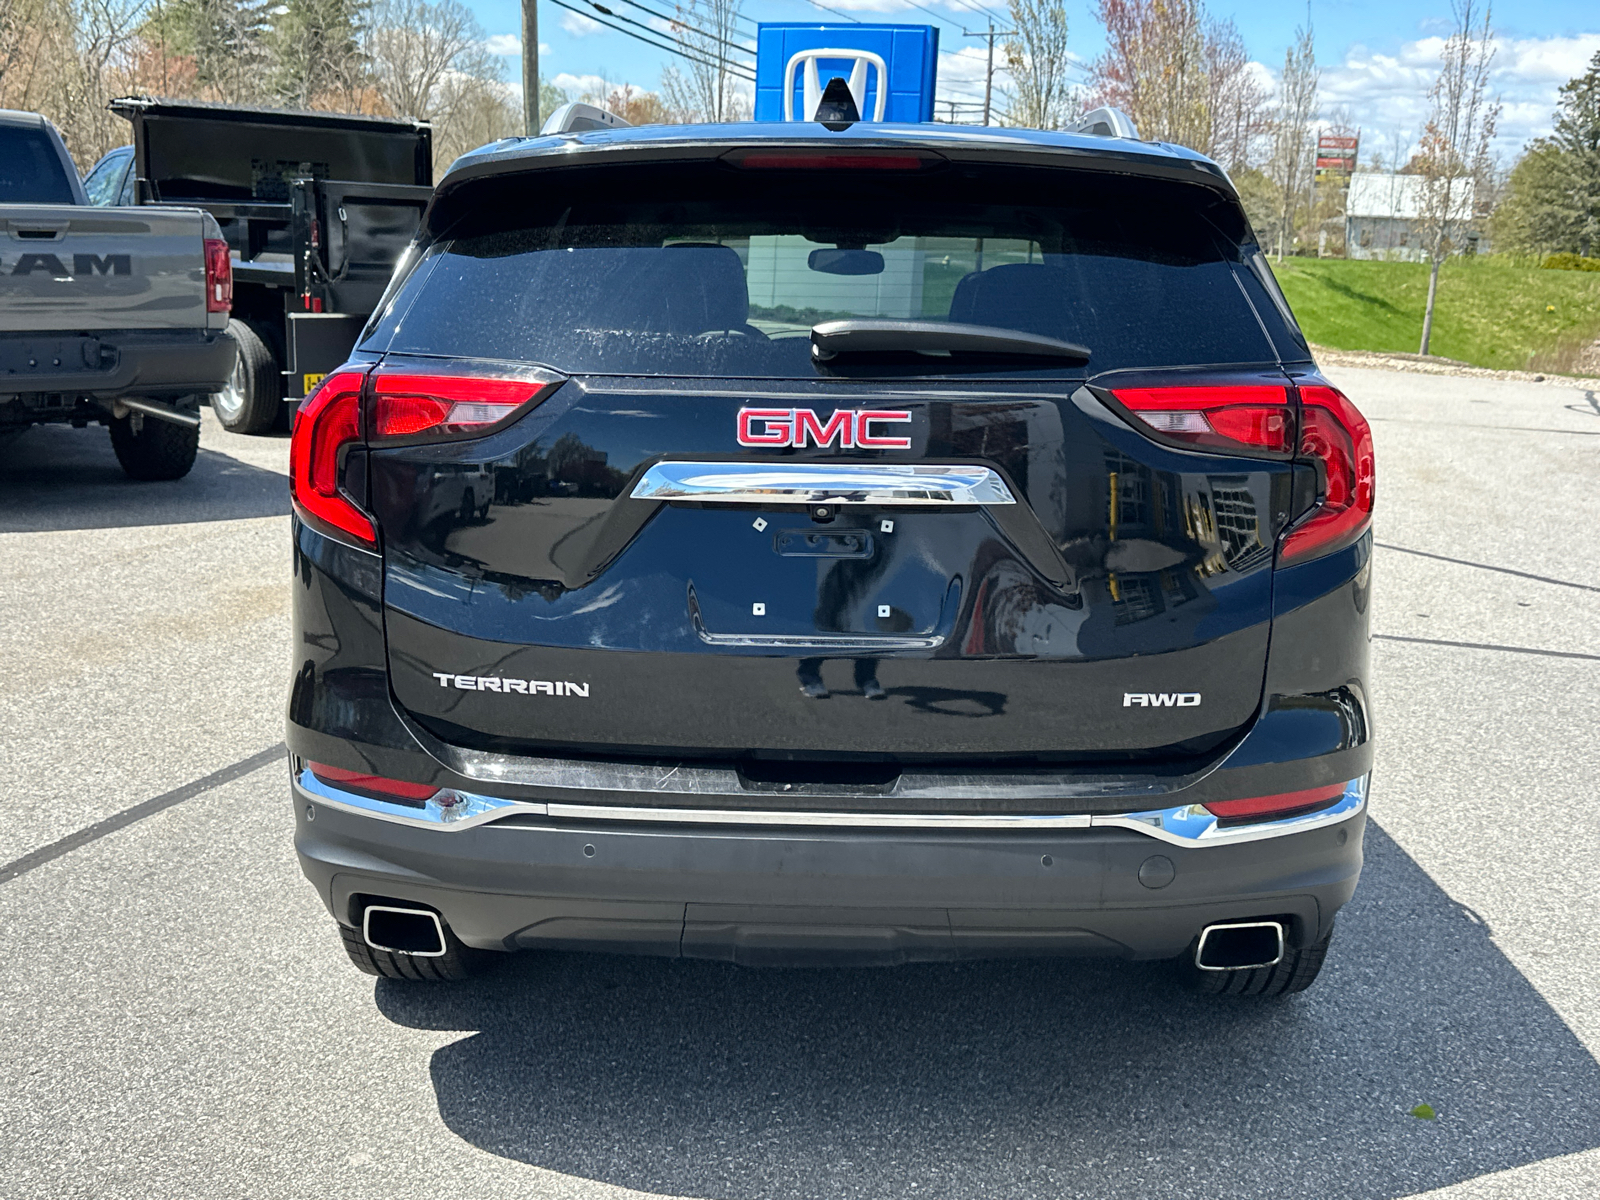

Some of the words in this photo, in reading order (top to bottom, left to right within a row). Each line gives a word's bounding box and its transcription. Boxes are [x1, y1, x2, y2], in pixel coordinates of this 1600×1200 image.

[0, 253, 131, 276] AM
[736, 407, 912, 449] GMC
[432, 672, 590, 698] TERRAIN
[1123, 692, 1202, 707] AWD
